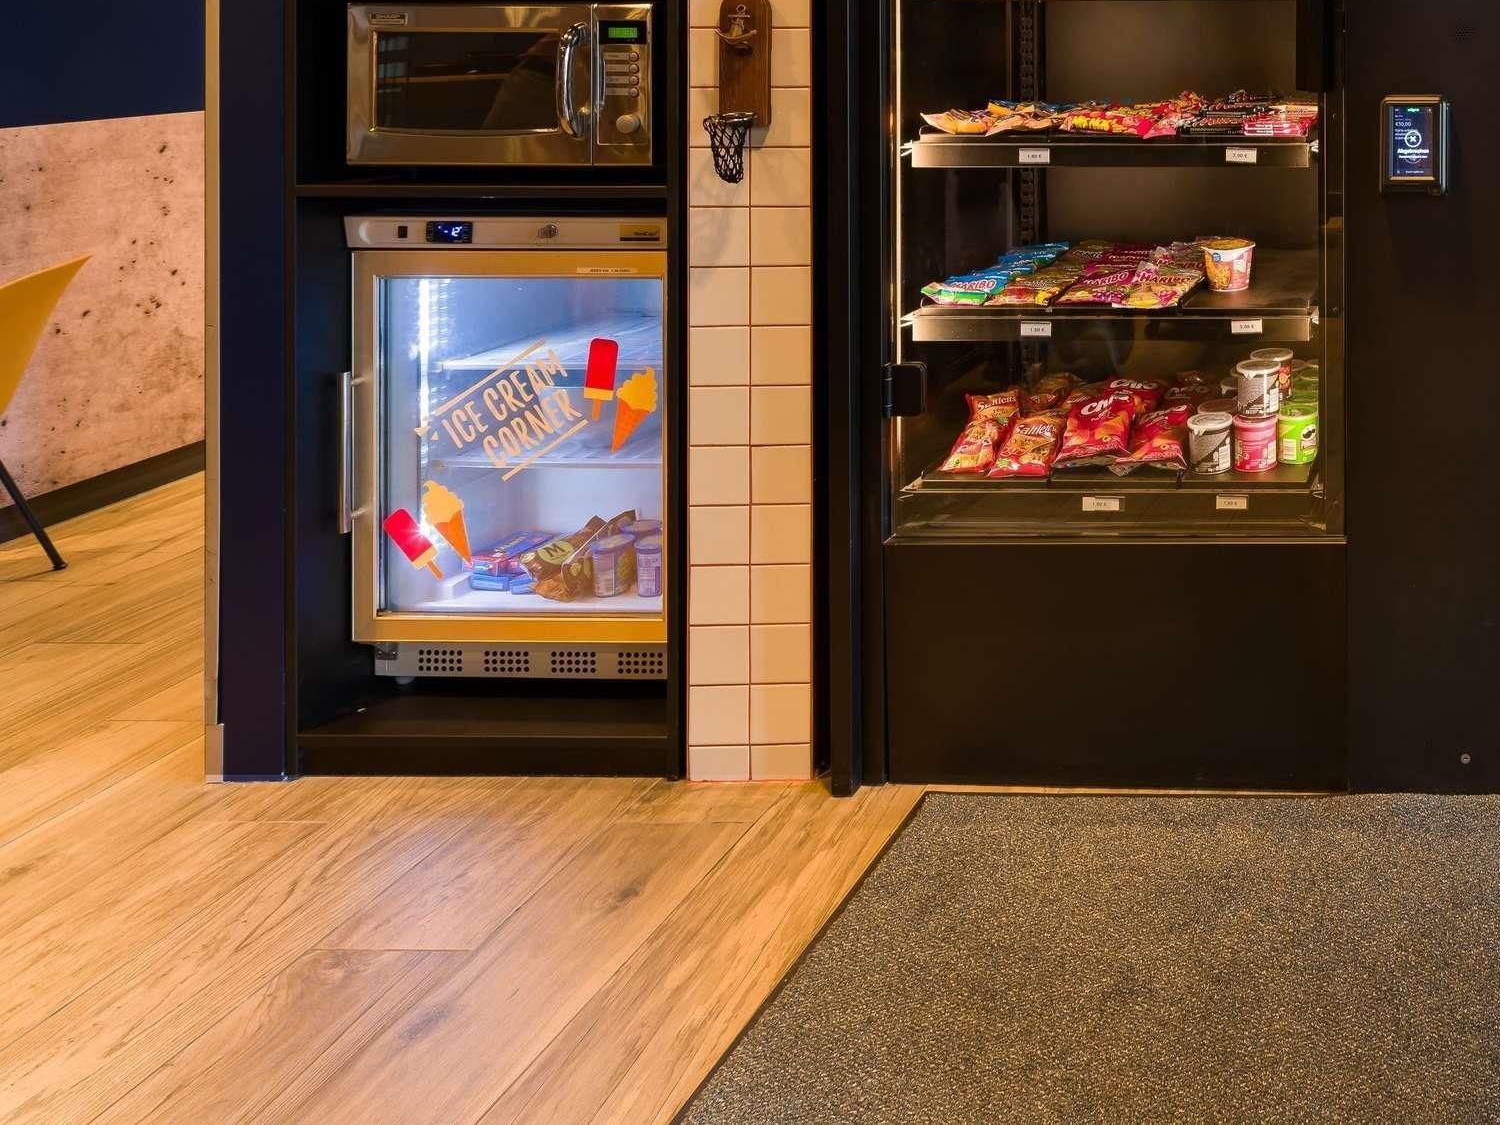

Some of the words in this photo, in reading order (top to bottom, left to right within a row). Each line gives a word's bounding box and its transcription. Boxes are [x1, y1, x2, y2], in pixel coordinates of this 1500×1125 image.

[442, 401, 489, 449] ICE
[483, 348, 568, 421] CREAM
[482, 388, 583, 469] CORNER
